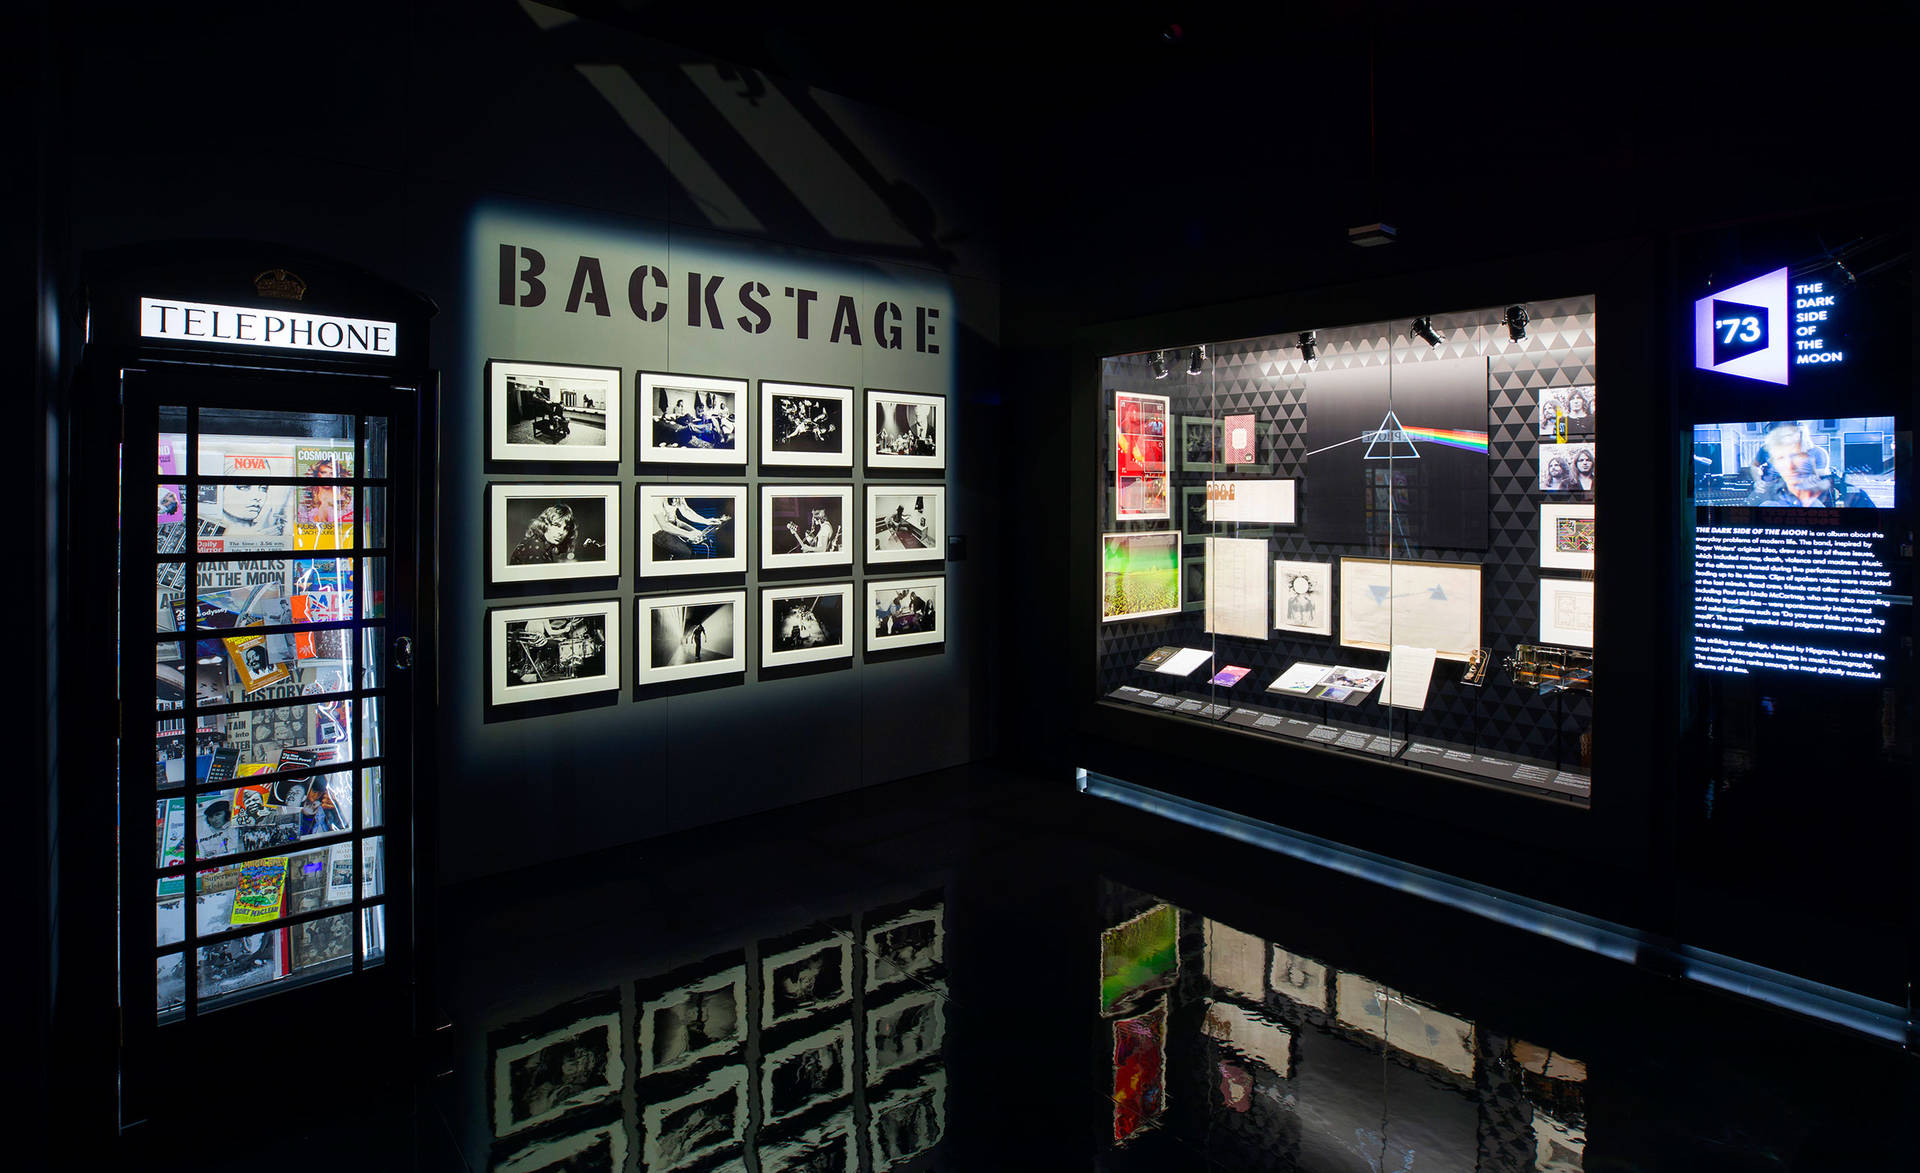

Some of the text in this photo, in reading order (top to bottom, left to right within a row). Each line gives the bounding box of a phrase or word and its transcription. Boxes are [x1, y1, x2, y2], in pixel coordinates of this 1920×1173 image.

[1796, 283, 1823, 294] THE
[499, 243, 940, 354] BACKSTAGE
[1796, 296, 1834, 308] DARK
[1796, 311, 1827, 322] SIDE
[151, 305, 391, 352] TELEPHONE
[1796, 326, 1816, 336] OF
[1796, 339, 1823, 350] THE
[1796, 352, 1843, 364] MOON
[298, 450, 354, 462] COSMOPOLITA
[234, 458, 266, 470] NOVA
[239, 560, 285, 570] WALKS
[215, 573, 241, 586] THE
[246, 571, 285, 585] MOON
